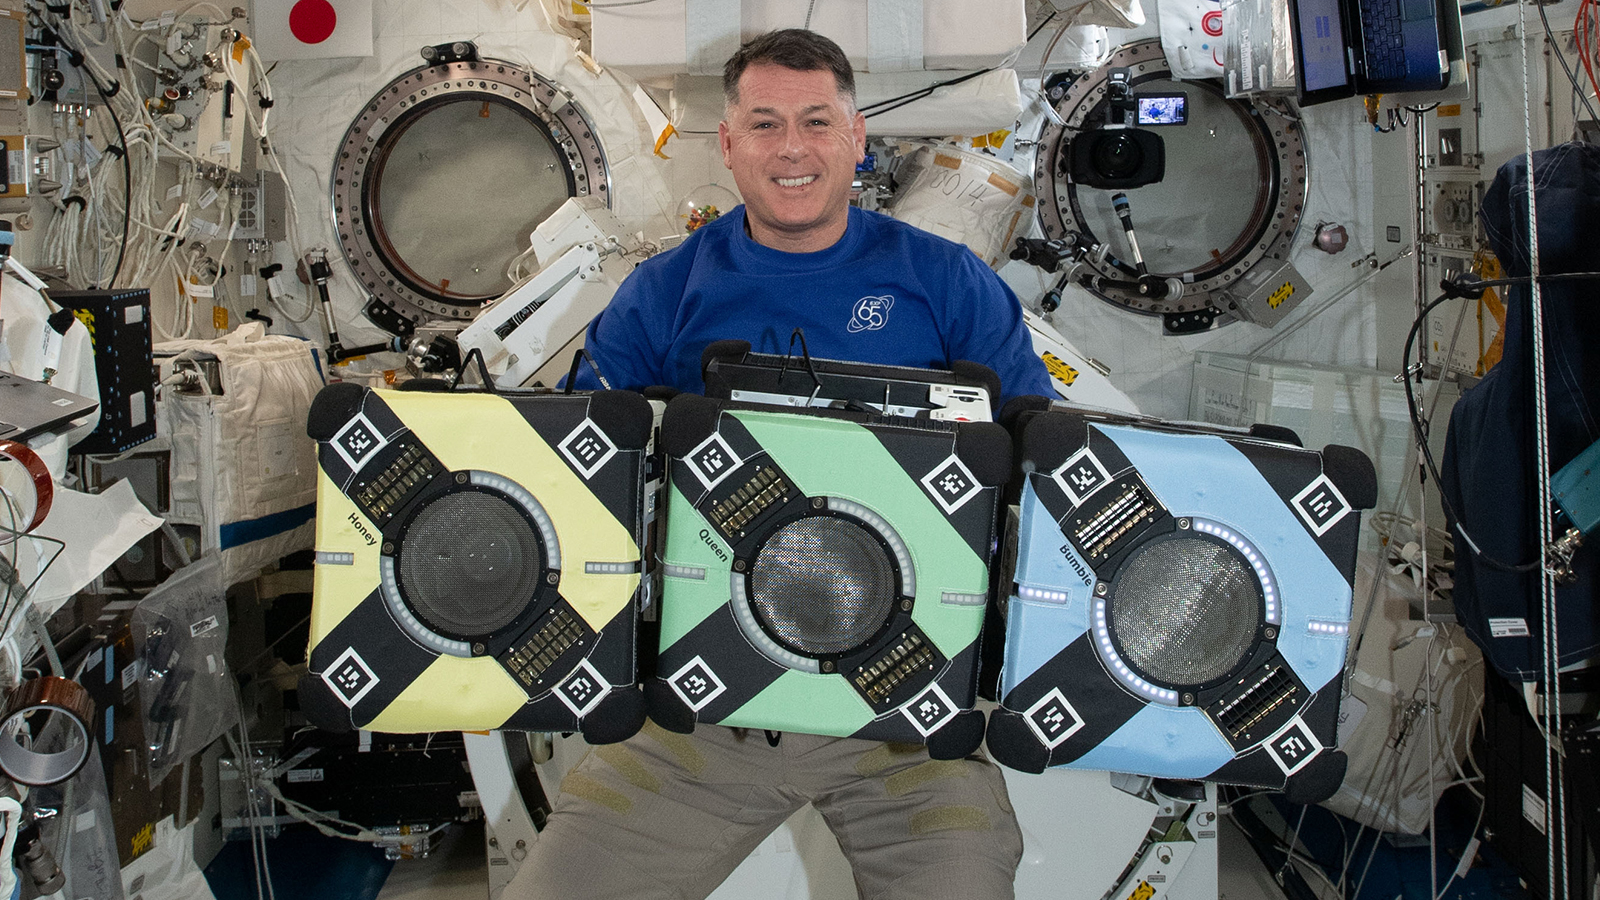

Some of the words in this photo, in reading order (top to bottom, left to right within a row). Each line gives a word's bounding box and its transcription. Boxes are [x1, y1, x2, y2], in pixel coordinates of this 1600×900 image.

[858, 300, 882, 326] 65
[347, 512, 377, 546] Honey
[699, 528, 728, 562] Queen
[1059, 543, 1092, 587] Bumble
